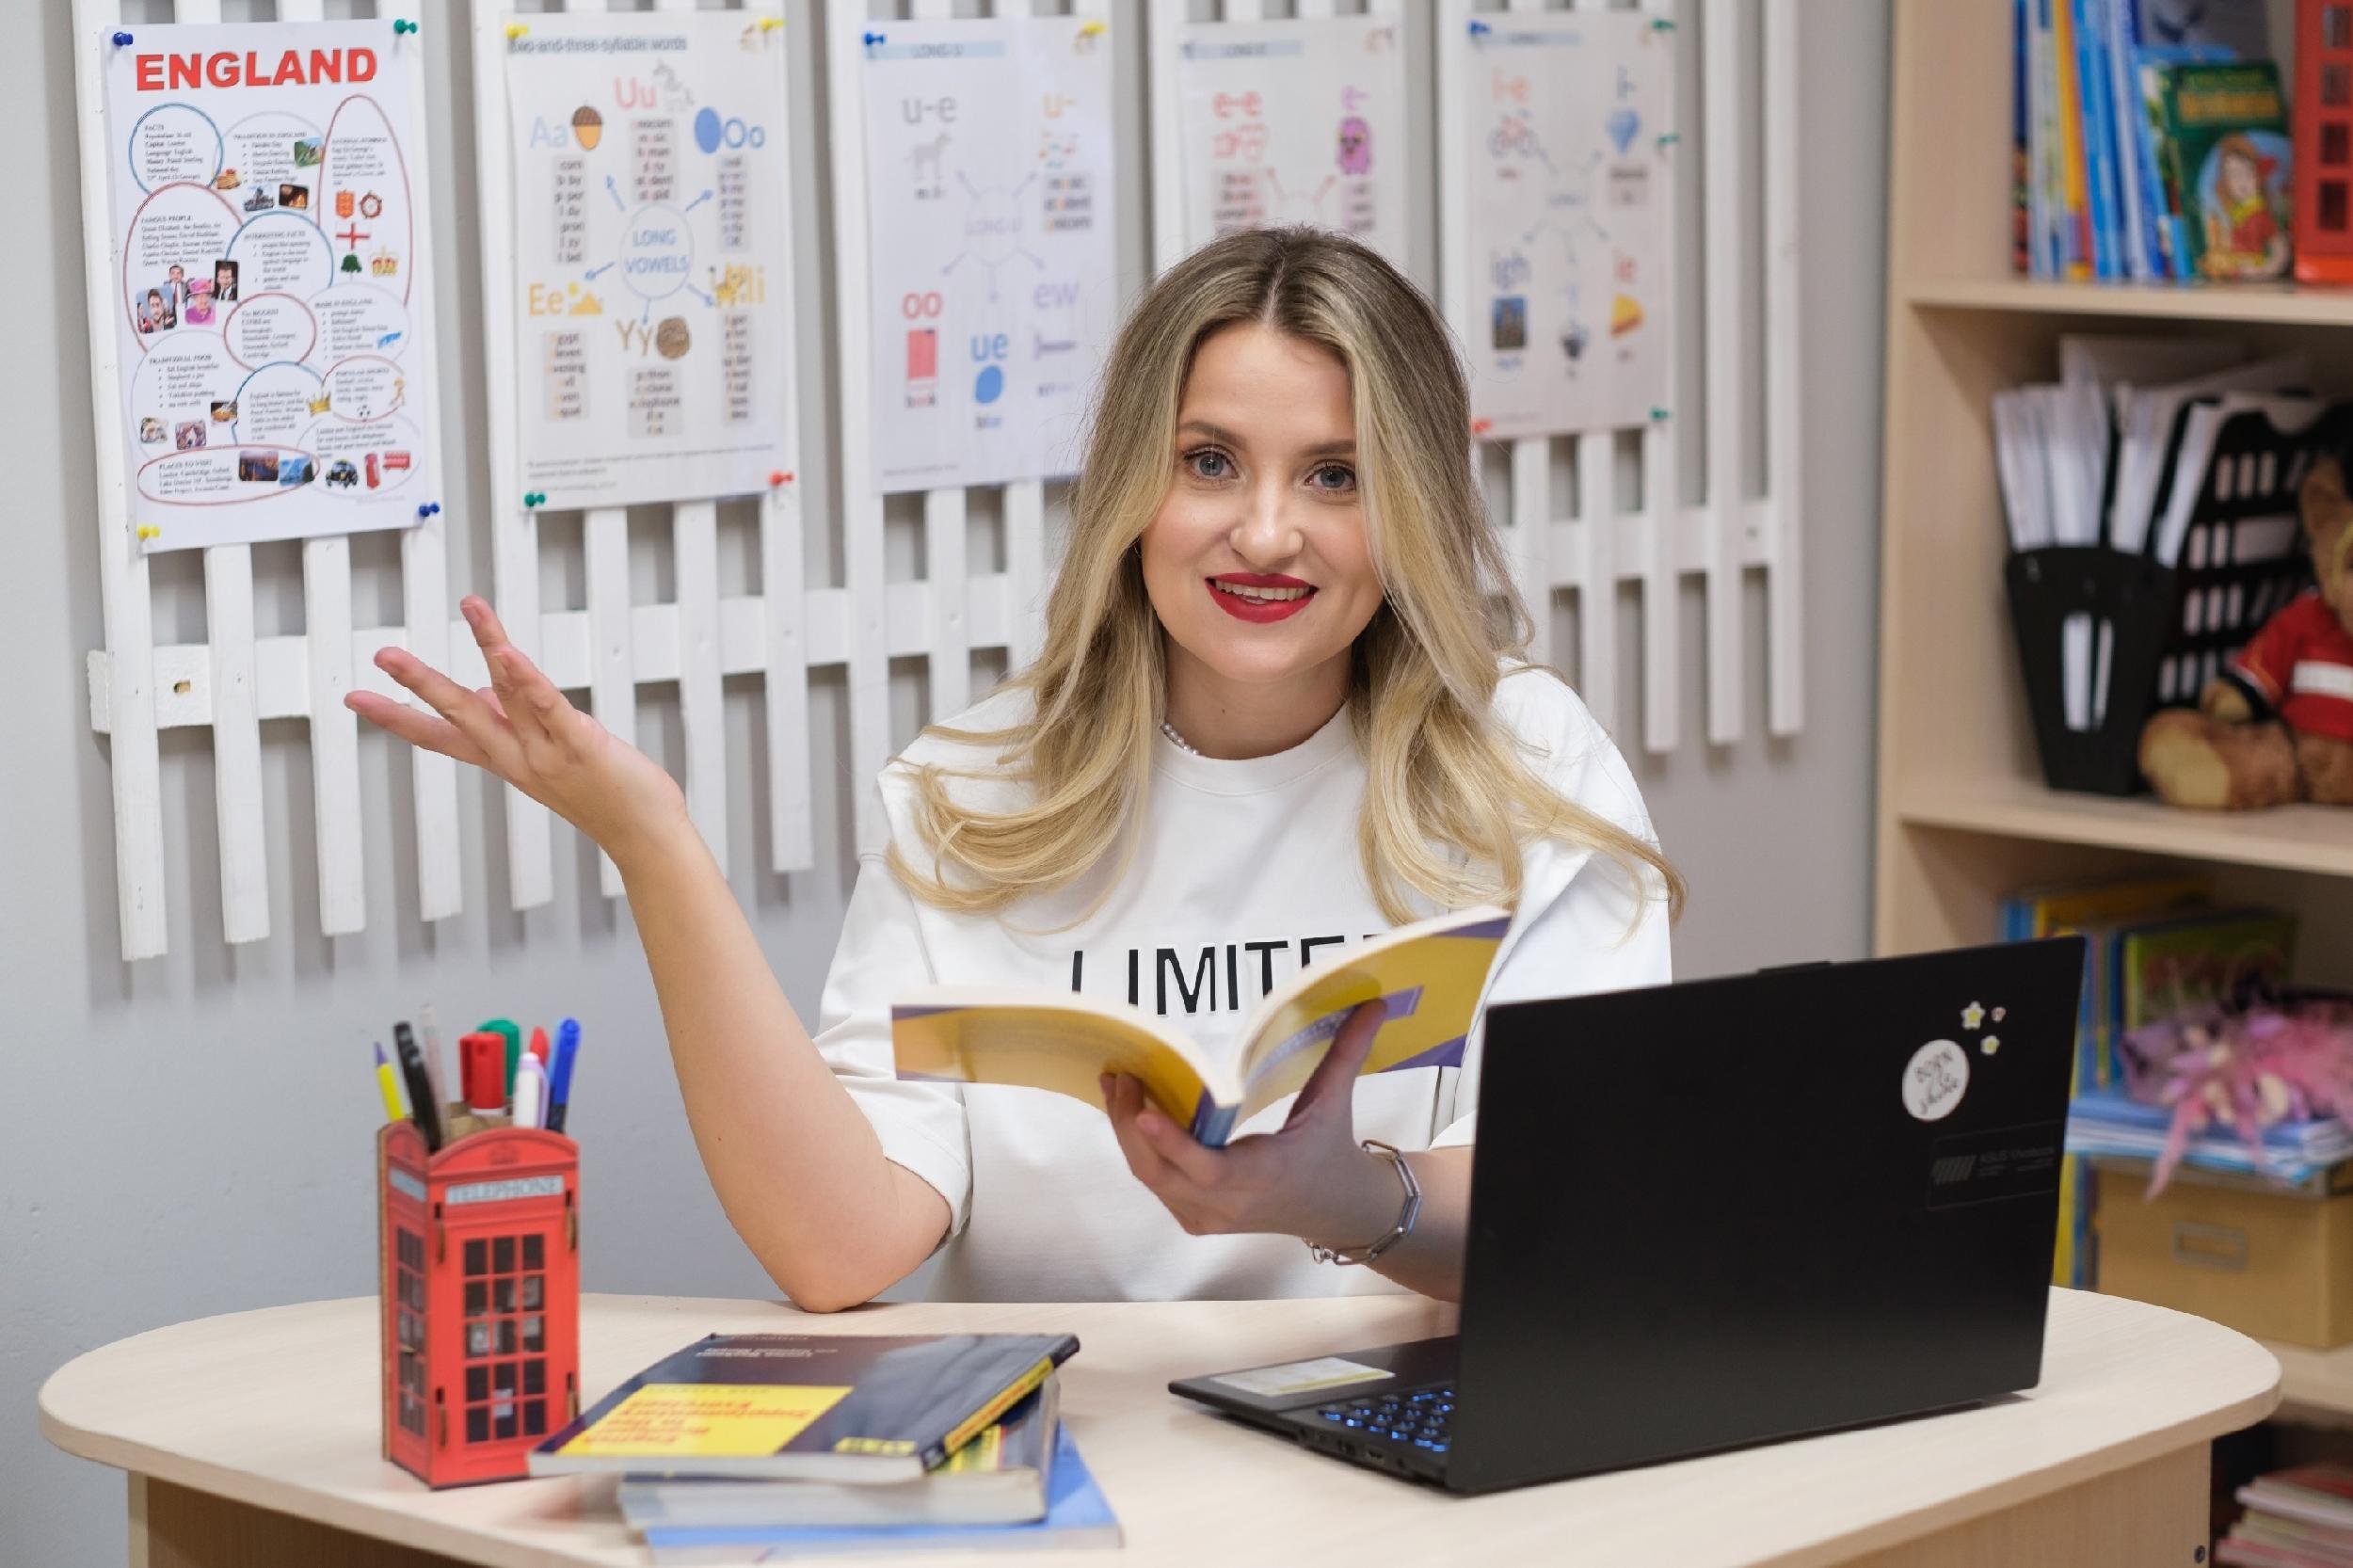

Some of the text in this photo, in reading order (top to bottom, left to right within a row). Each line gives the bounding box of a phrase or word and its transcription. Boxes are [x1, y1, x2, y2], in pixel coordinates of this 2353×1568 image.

[136, 48, 377, 92] ENGLAND
[615, 76, 657, 110] Uu
[903, 97, 956, 124] u-e
[530, 116, 568, 150] Aa
[724, 118, 765, 150] Oo
[632, 229, 678, 248] LONG
[625, 255, 689, 274] VOWELS
[529, 282, 565, 316] Ee
[902, 291, 944, 320] oo
[1032, 282, 1080, 310] ew
[616, 318, 652, 357] Yy
[970, 332, 1009, 362] ue
[452, 1176, 560, 1203] TELEPHONE
